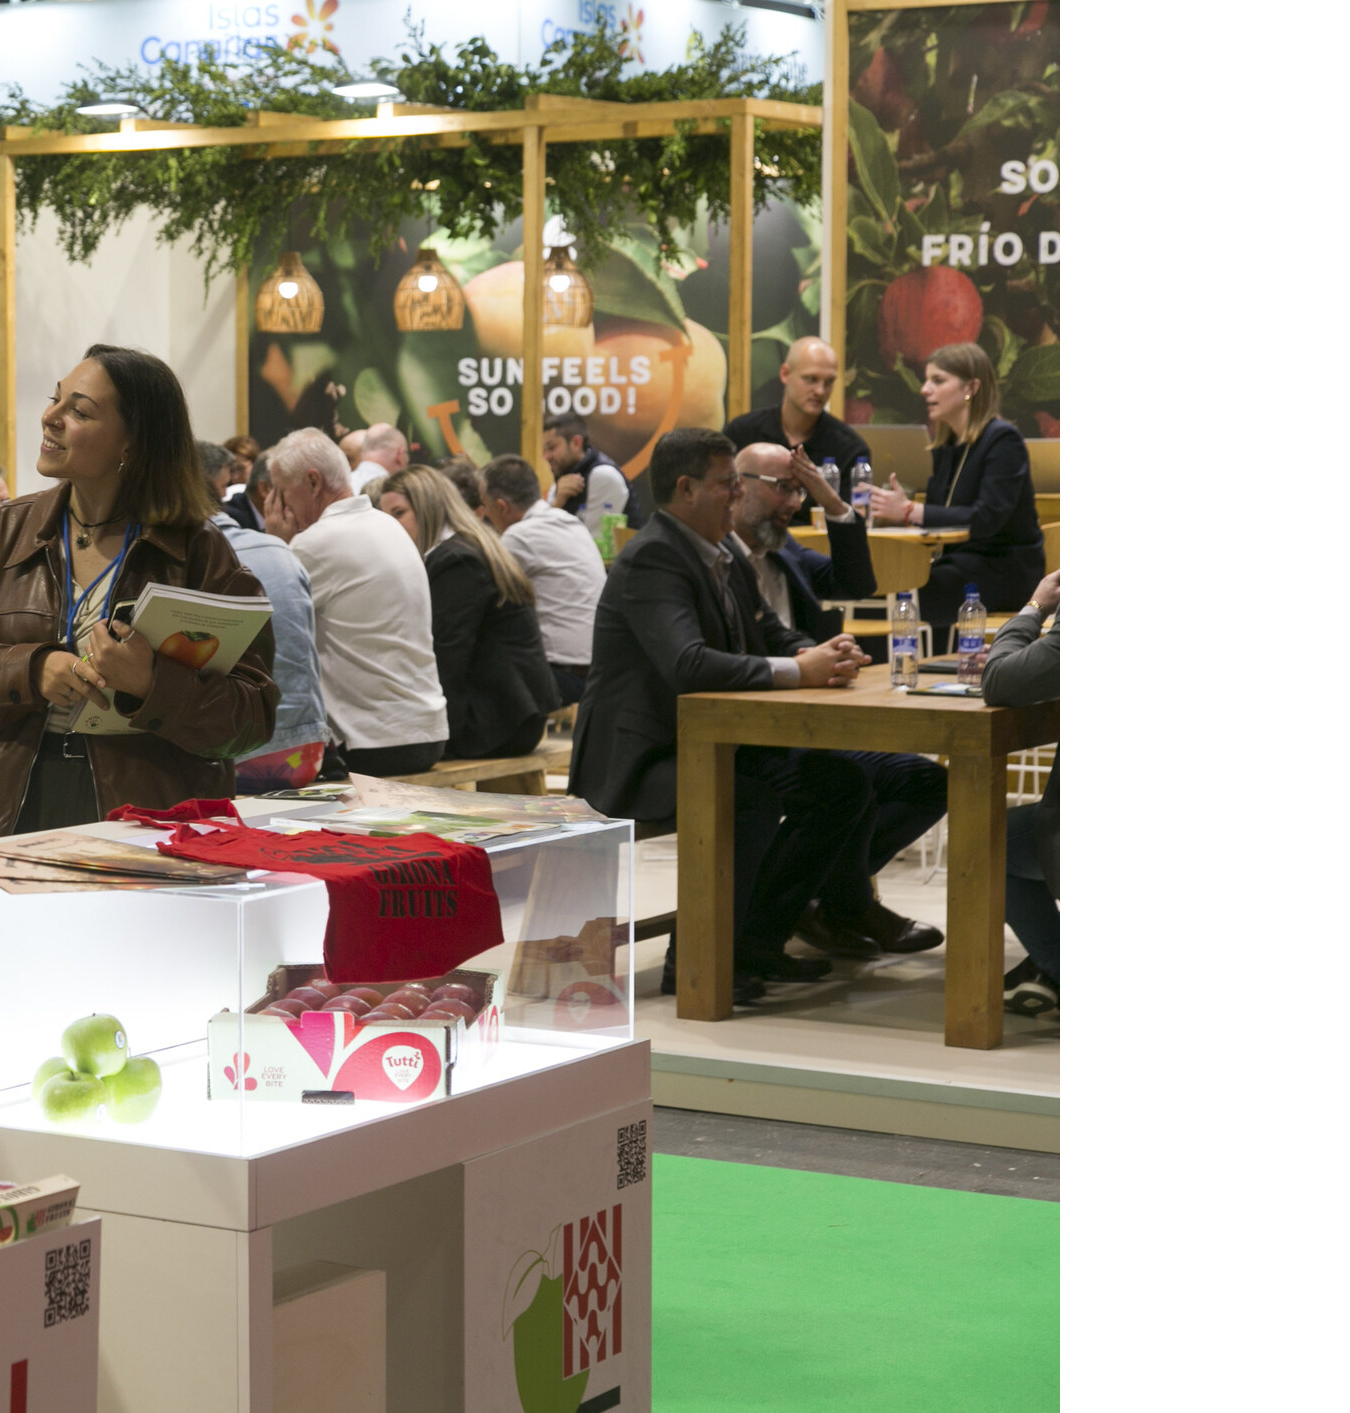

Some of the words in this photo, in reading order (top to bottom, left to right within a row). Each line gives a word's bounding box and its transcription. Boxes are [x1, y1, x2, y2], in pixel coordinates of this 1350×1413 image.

[209, 3, 279, 30] Islas
[922, 221, 1023, 266] FRÍO
[458, 357, 523, 386] SUN
[542, 356, 651, 385] FEELS
[468, 387, 513, 416] SO
[542, 387, 636, 416] OOD!
[368, 860, 456, 886] GIRONA
[379, 889, 458, 918] FRUITS
